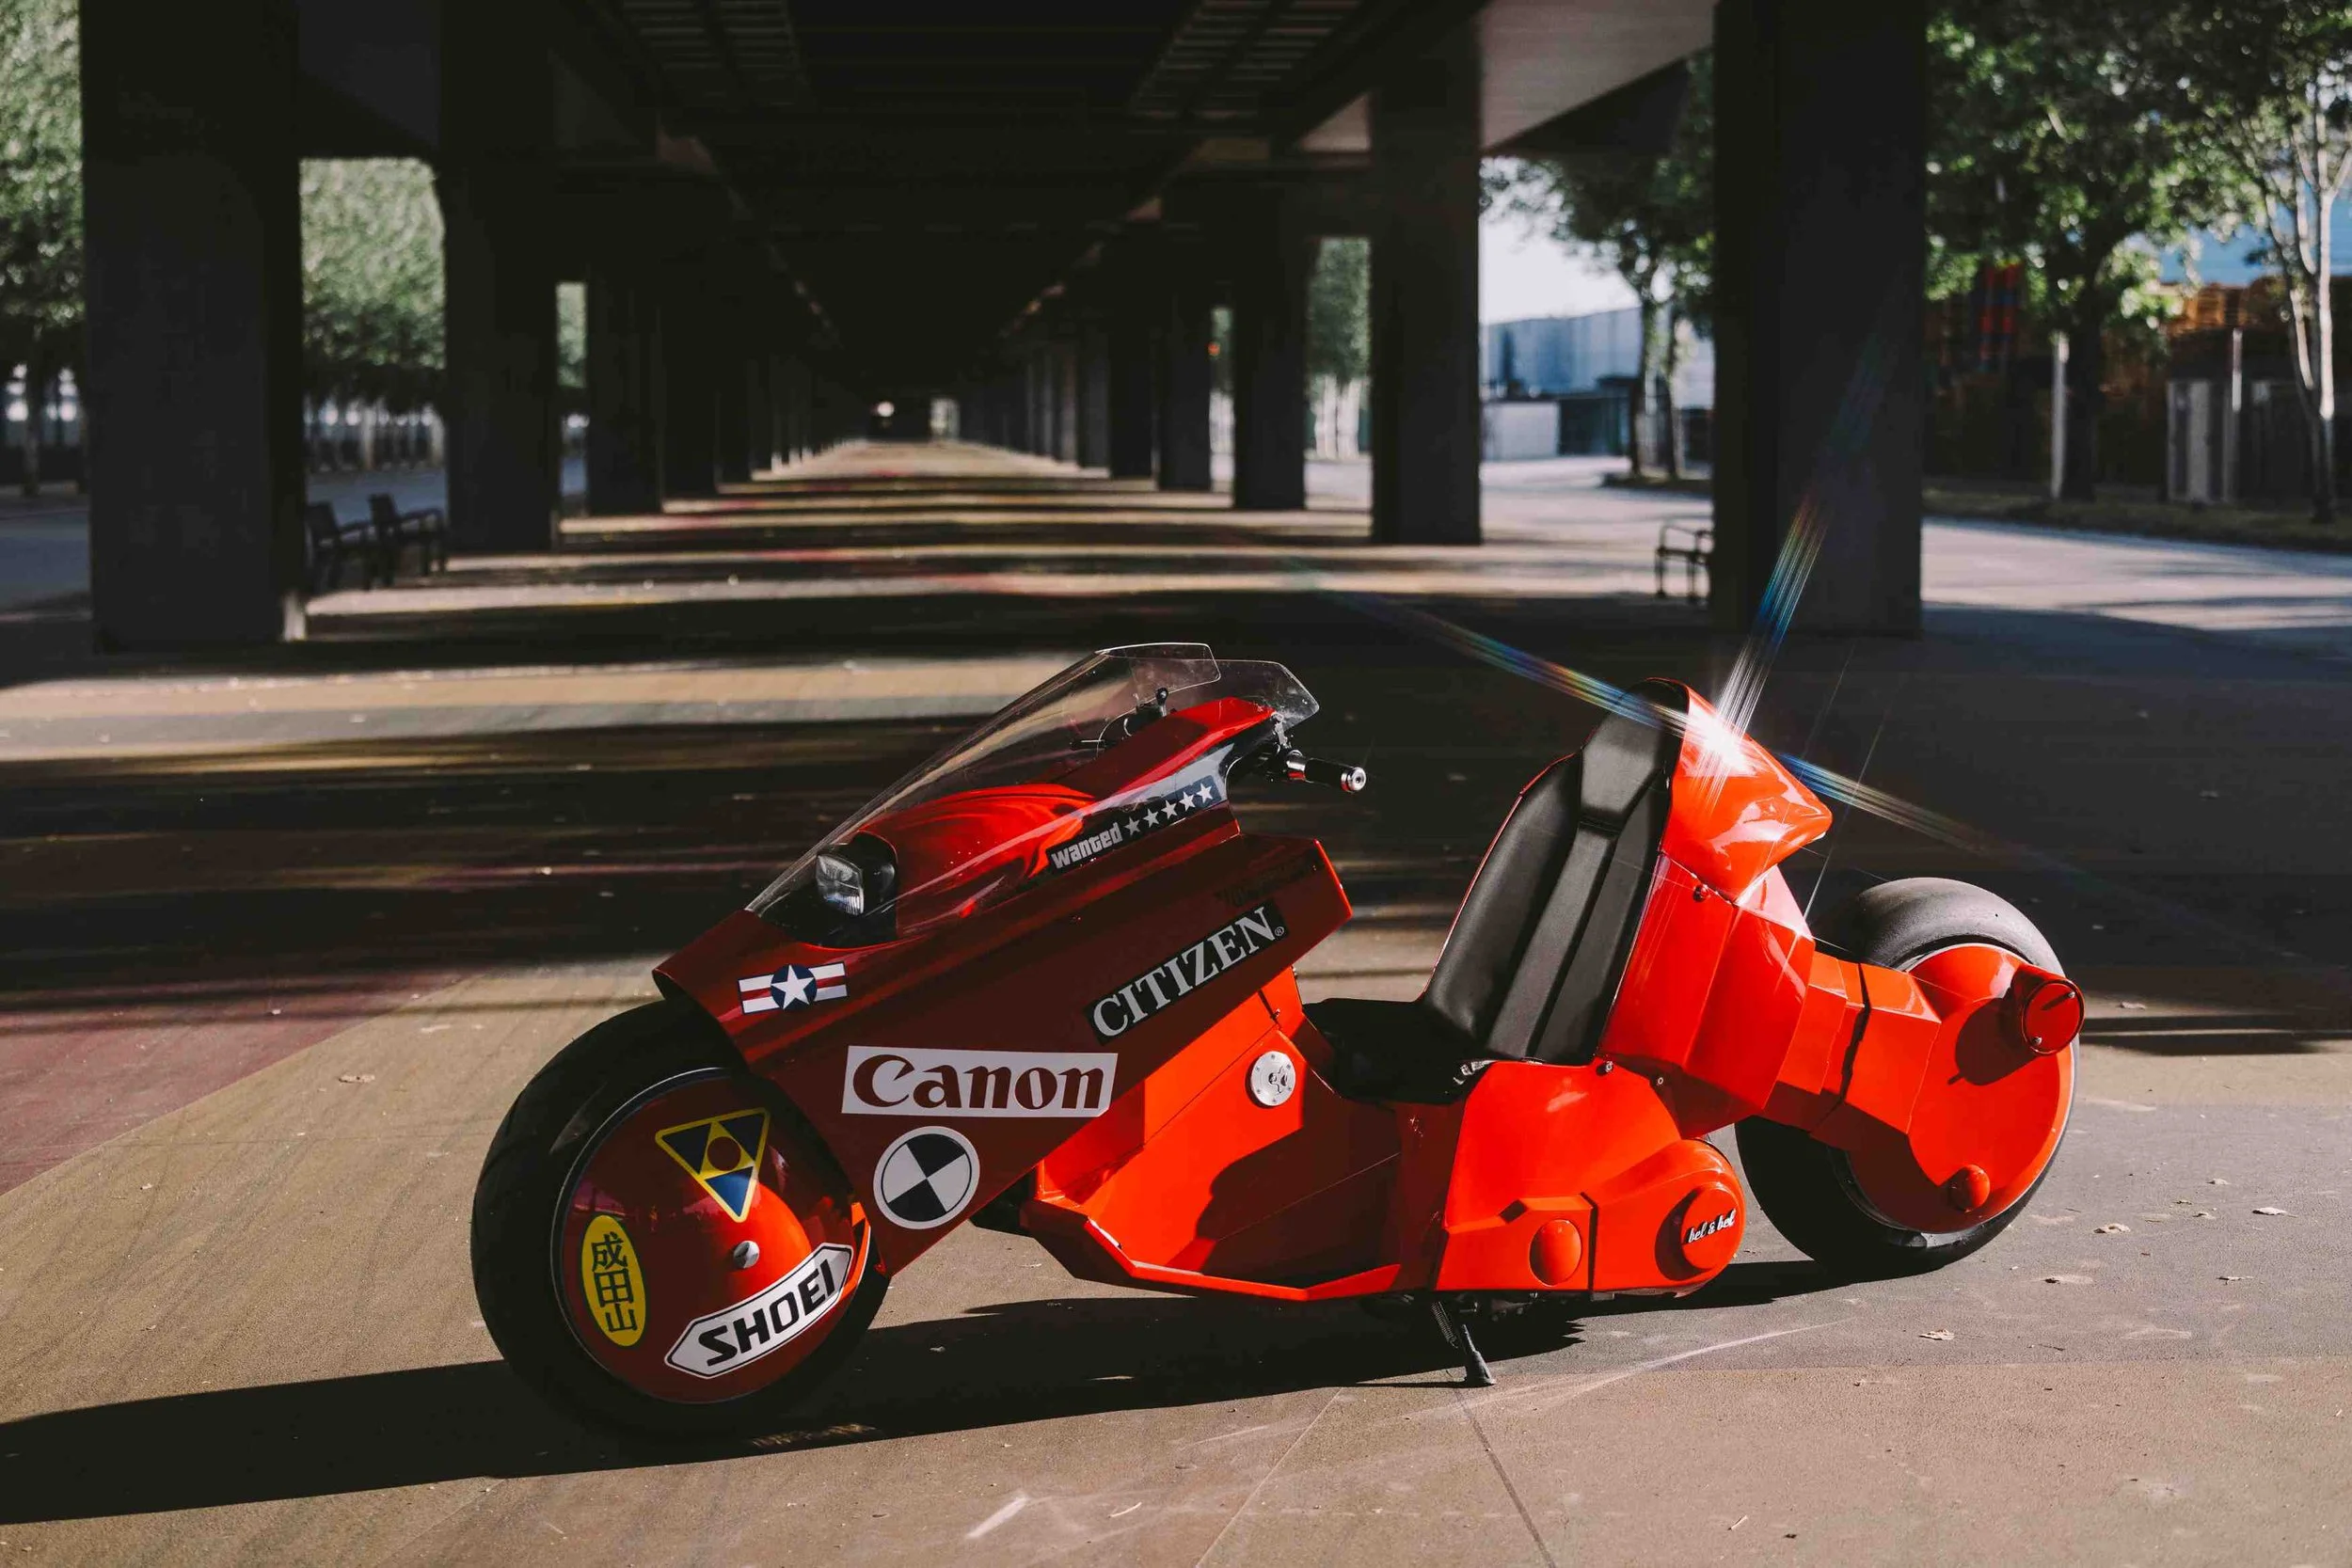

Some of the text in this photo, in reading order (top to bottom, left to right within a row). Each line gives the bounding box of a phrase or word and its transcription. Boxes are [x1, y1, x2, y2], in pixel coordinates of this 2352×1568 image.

[1052, 822, 1122, 869] wanted
[852, 1053, 1104, 1110] Canon
[590, 1232, 638, 1331] 成田山
[698, 1258, 836, 1368] SHOEI
